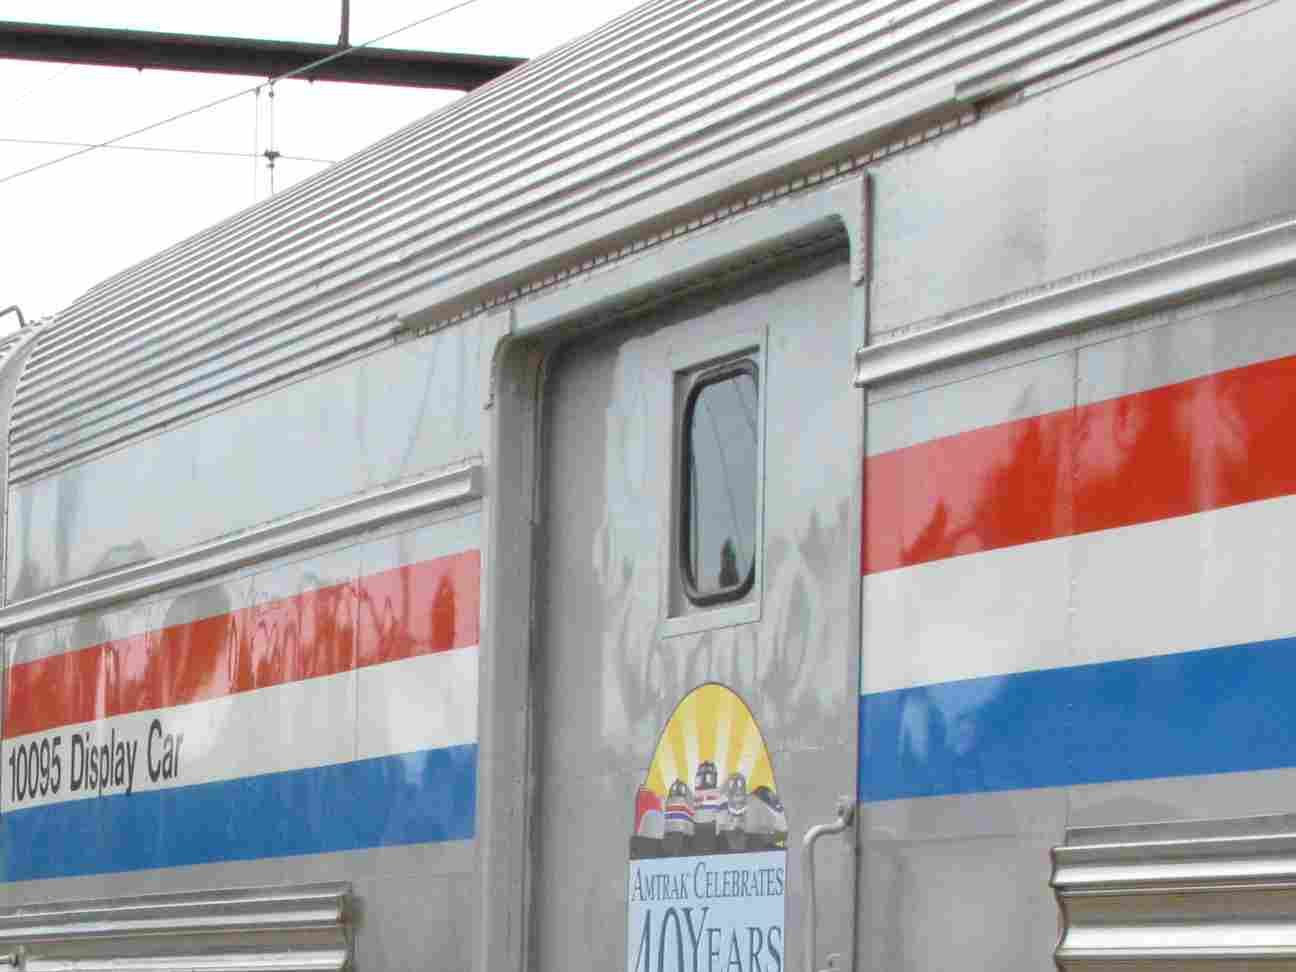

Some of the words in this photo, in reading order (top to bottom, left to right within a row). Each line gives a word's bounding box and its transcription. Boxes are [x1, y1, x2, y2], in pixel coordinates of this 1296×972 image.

[8, 735, 62, 802] 10095
[69, 726, 137, 799] Display
[147, 718, 184, 783] Car
[631, 867, 689, 902] AMTRAK
[693, 861, 785, 899] CELEBRATES
